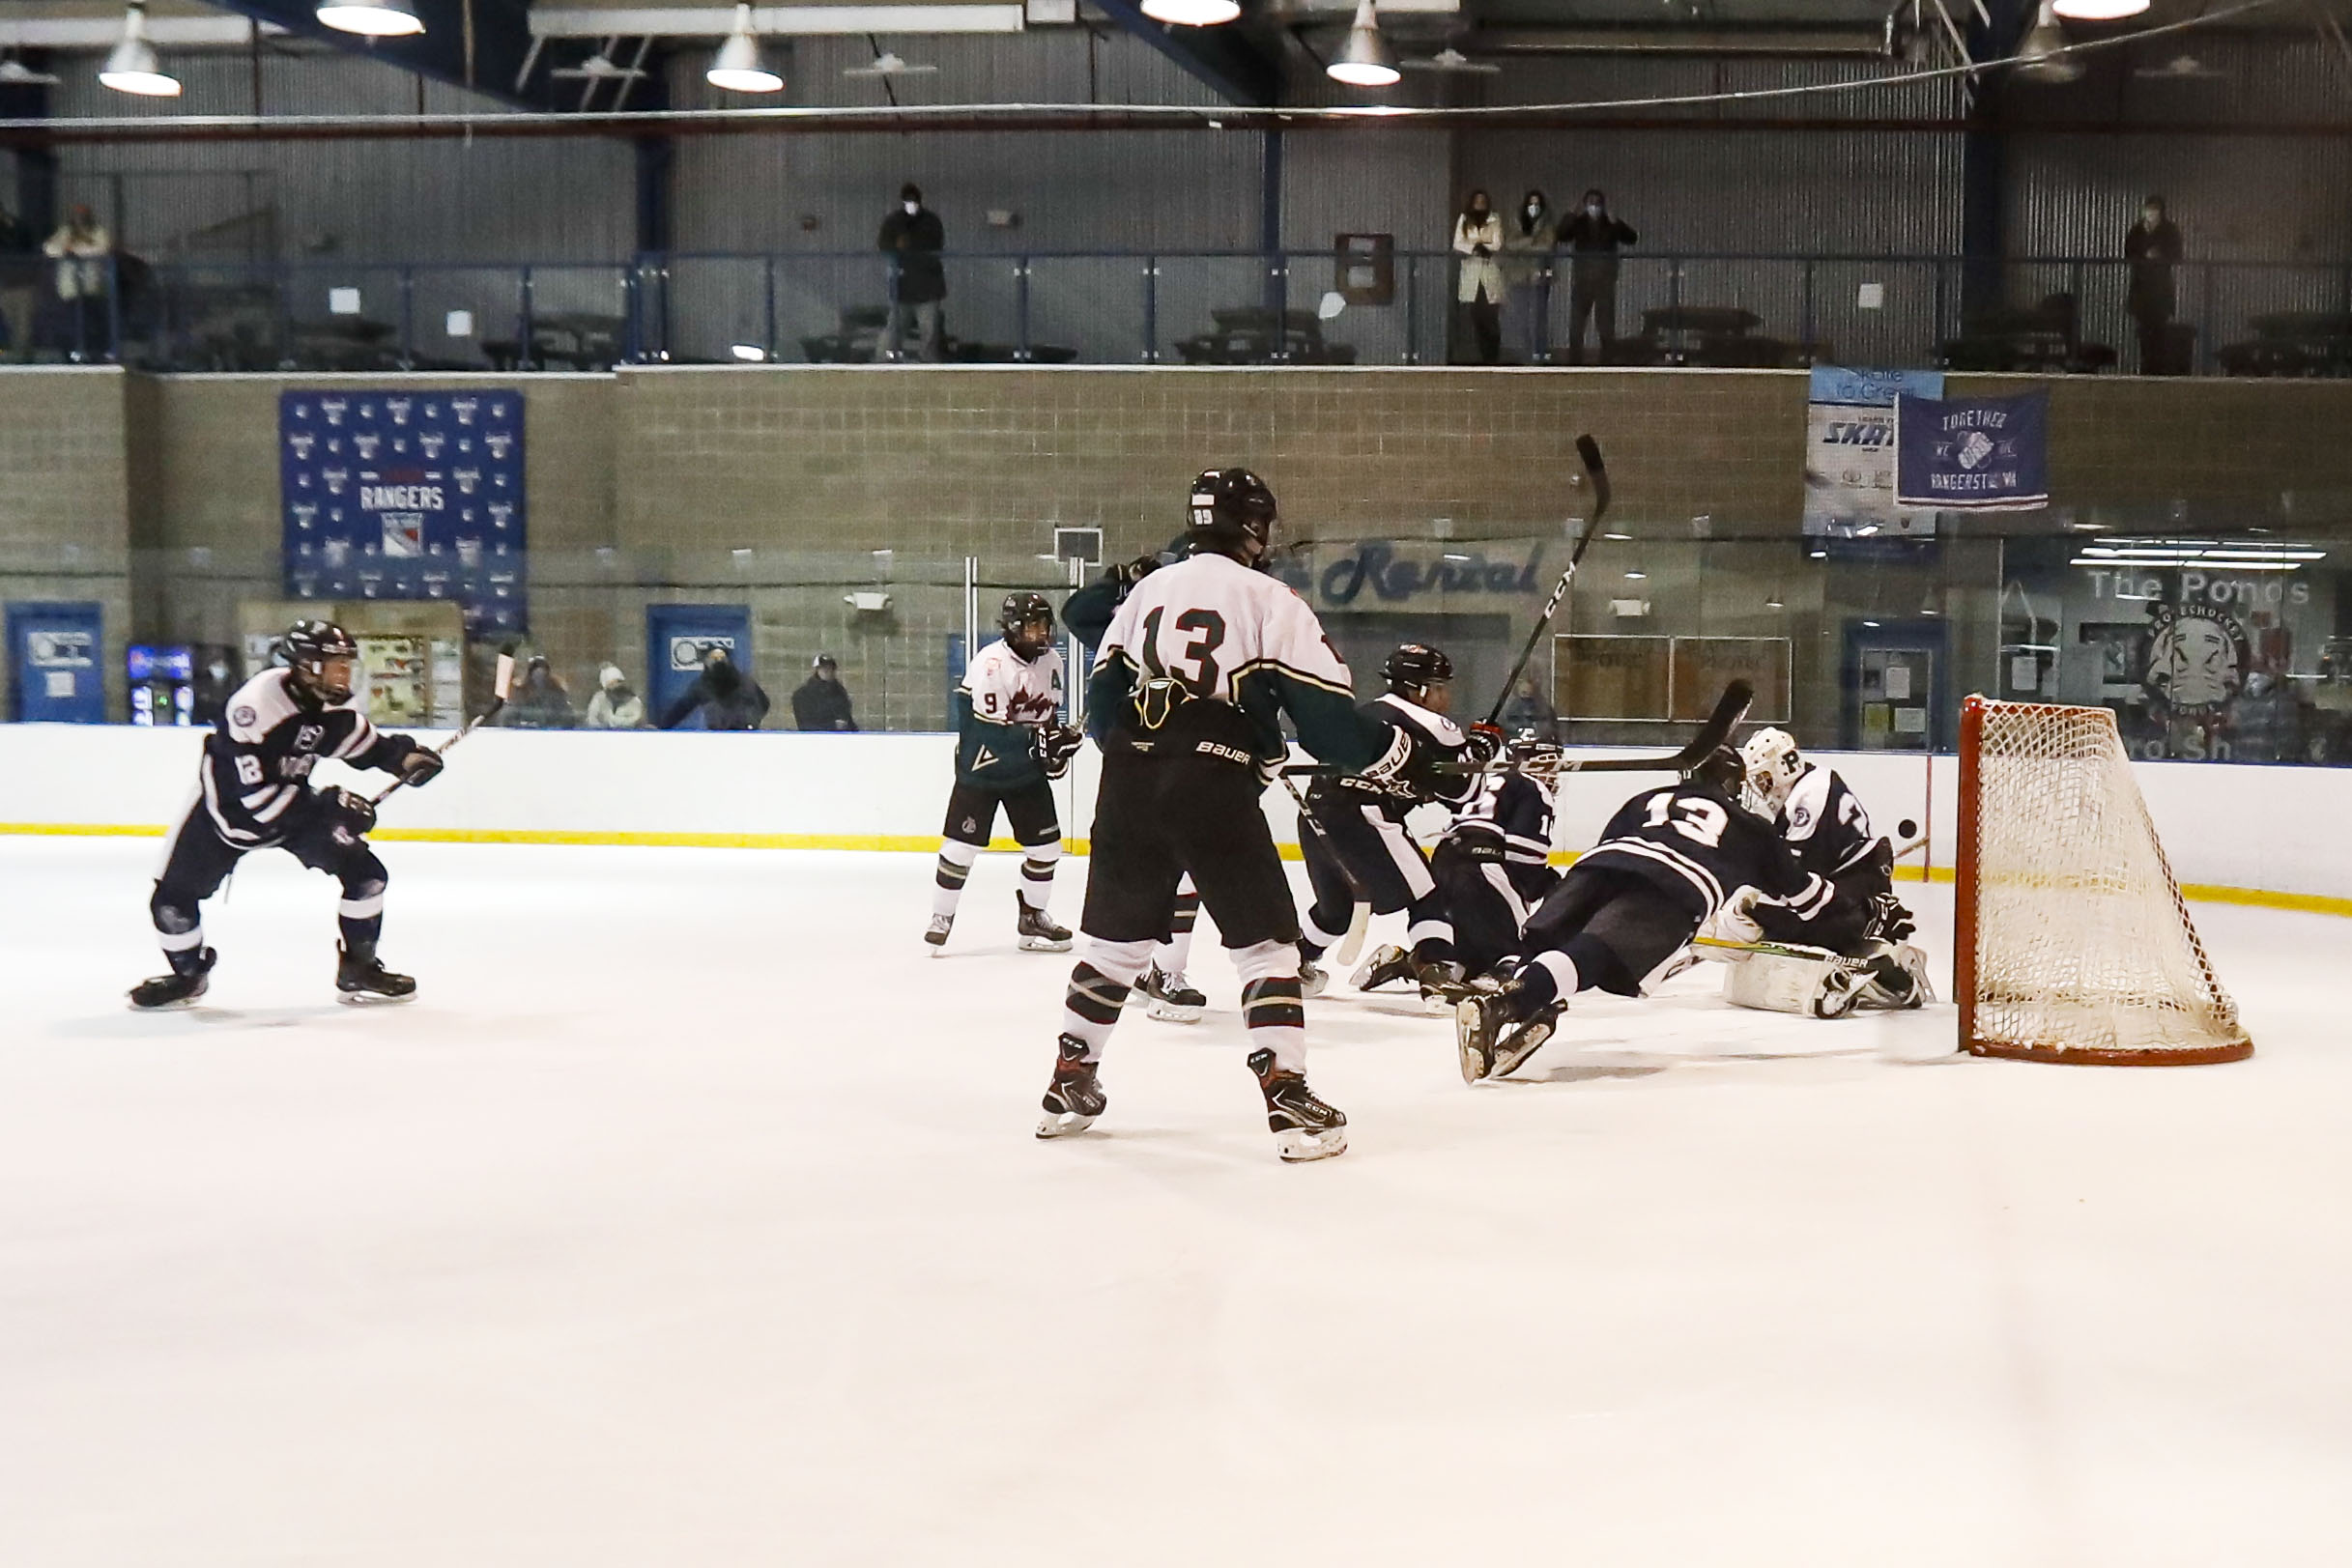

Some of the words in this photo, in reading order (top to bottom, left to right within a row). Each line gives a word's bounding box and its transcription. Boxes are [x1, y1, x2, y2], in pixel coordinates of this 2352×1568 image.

[1942, 410, 2007, 432] TOGETHER
[359, 485, 445, 511] RANGERS
[1320, 539, 1545, 606] Rental
[2087, 570, 2164, 598] The
[1544, 560, 1577, 619] CCM
[1142, 605, 1226, 698] 13
[1050, 669, 1063, 690] A
[984, 692, 998, 714] 9
[1482, 759, 1584, 773] CCM
[1781, 750, 1800, 774] P
[1641, 791, 1730, 849] 13
